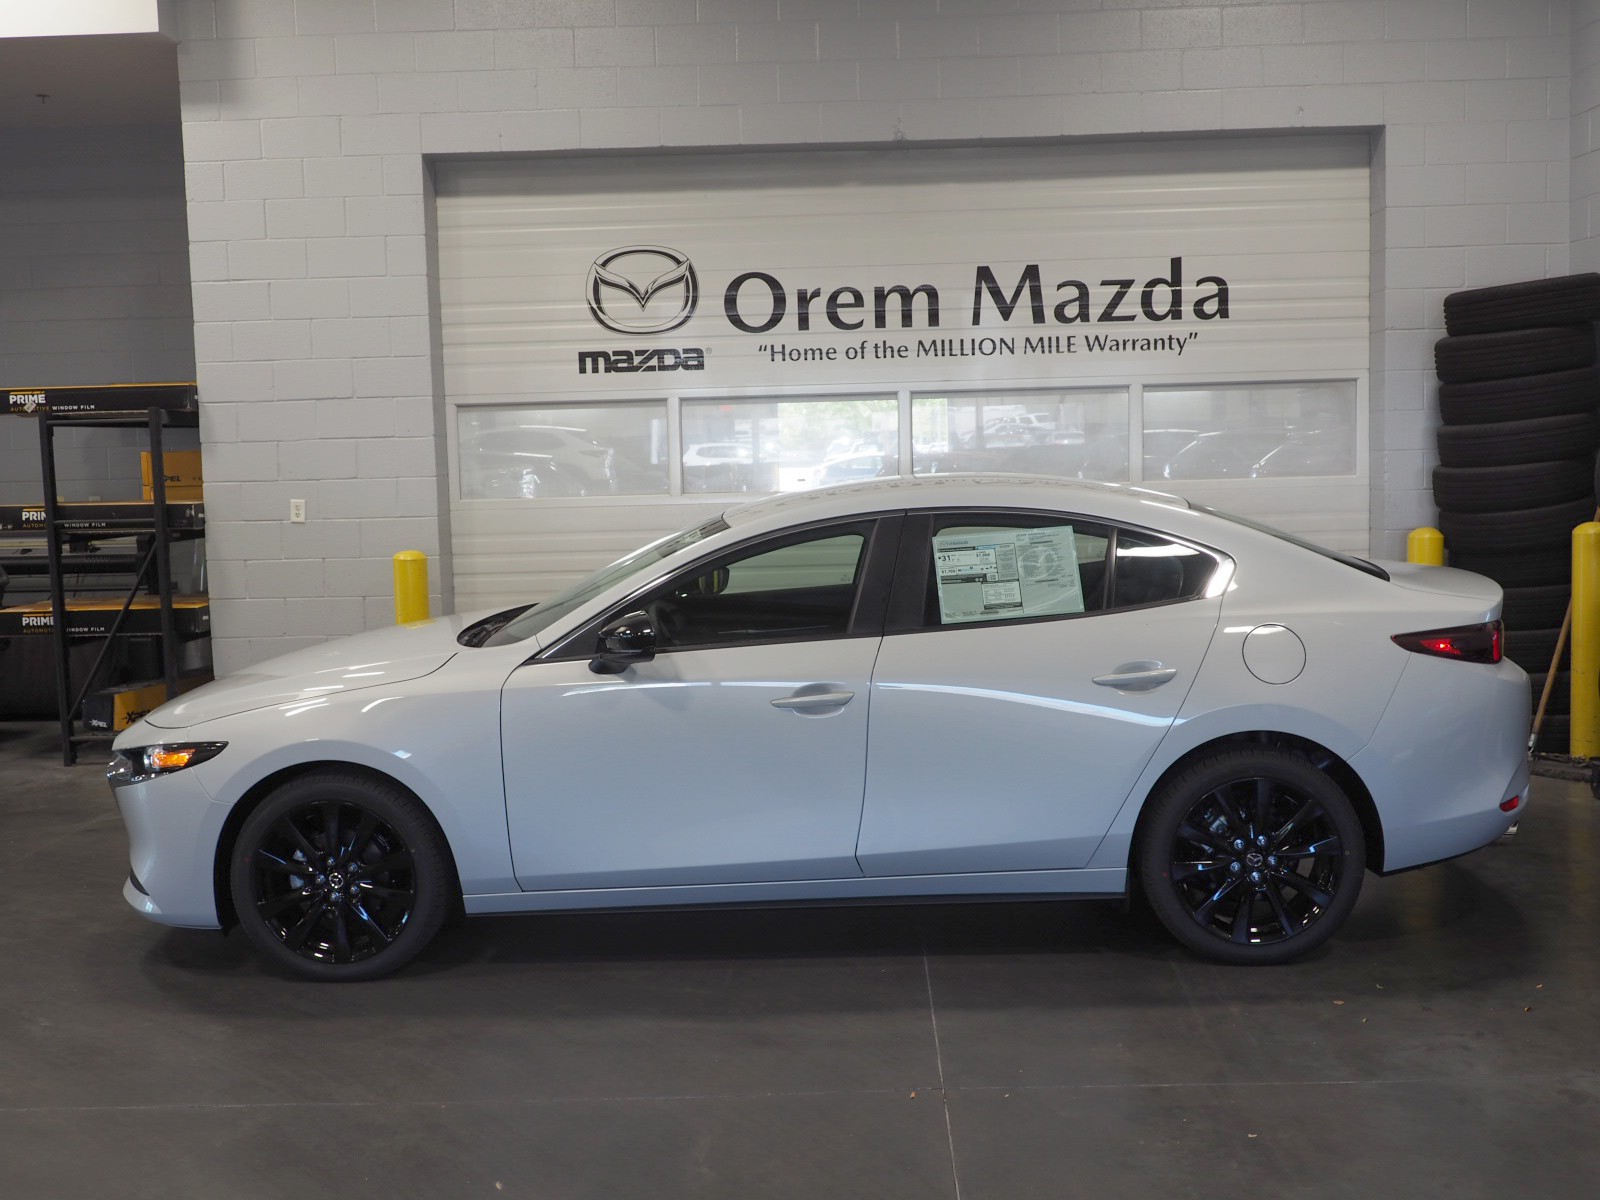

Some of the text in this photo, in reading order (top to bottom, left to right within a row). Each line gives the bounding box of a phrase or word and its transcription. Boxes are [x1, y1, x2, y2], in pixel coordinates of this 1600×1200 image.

[724, 257, 1231, 334] Orem Mazda
[578, 347, 705, 374] mazda
[845, 340, 866, 360] of
[873, 339, 909, 359] the
[916, 337, 1016, 358] MILLION
[1023, 335, 1077, 354] MILE
[9, 394, 46, 404] PRIME
